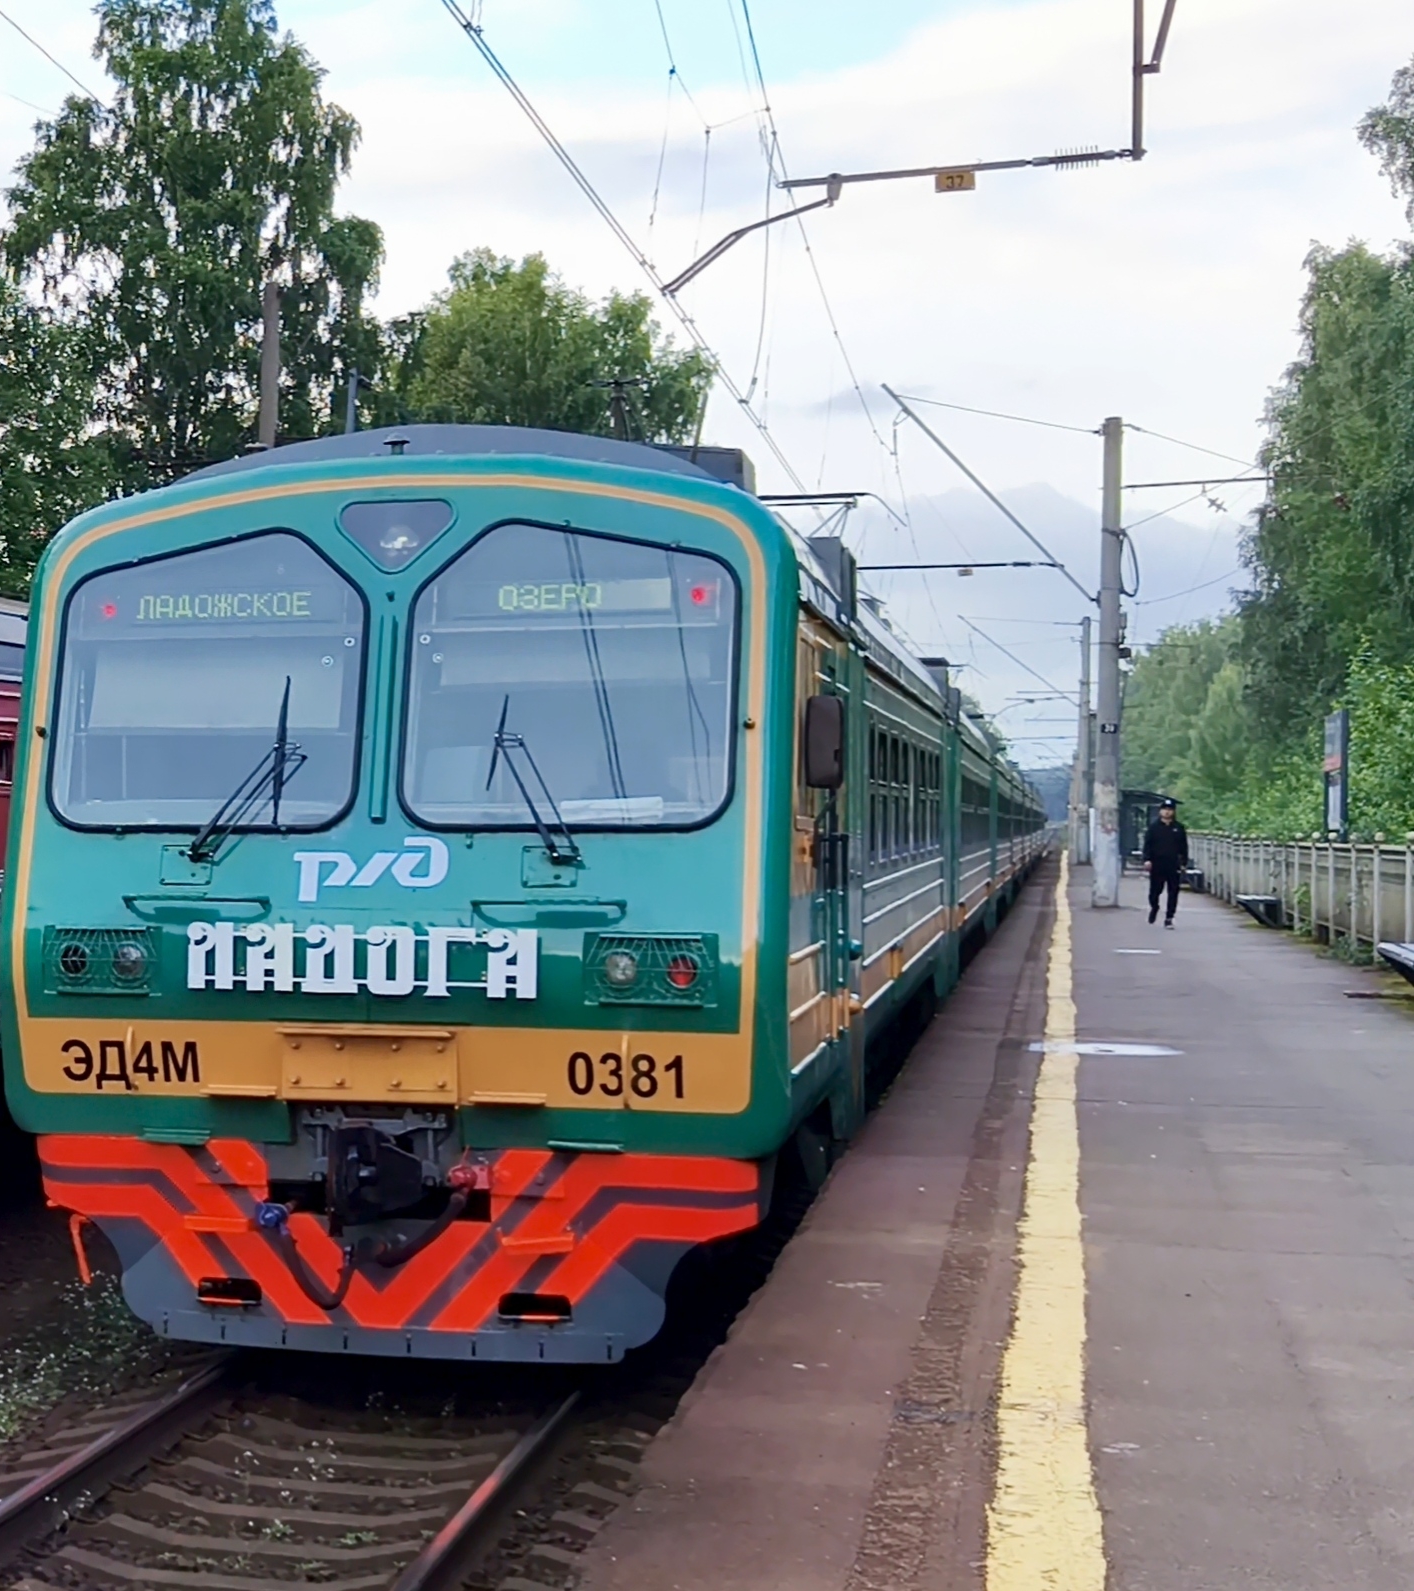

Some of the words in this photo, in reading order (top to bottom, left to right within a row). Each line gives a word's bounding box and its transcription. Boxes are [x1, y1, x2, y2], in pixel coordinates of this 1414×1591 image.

[945, 174, 964, 189] 37
[137, 592, 311, 619] ЛАДОЖСКОЕ
[499, 583, 602, 611] ОЗЕРО
[186, 921, 538, 999] ЛАДОГА
[61, 1039, 200, 1090] ЭД4М
[568, 1051, 684, 1099] 0381
